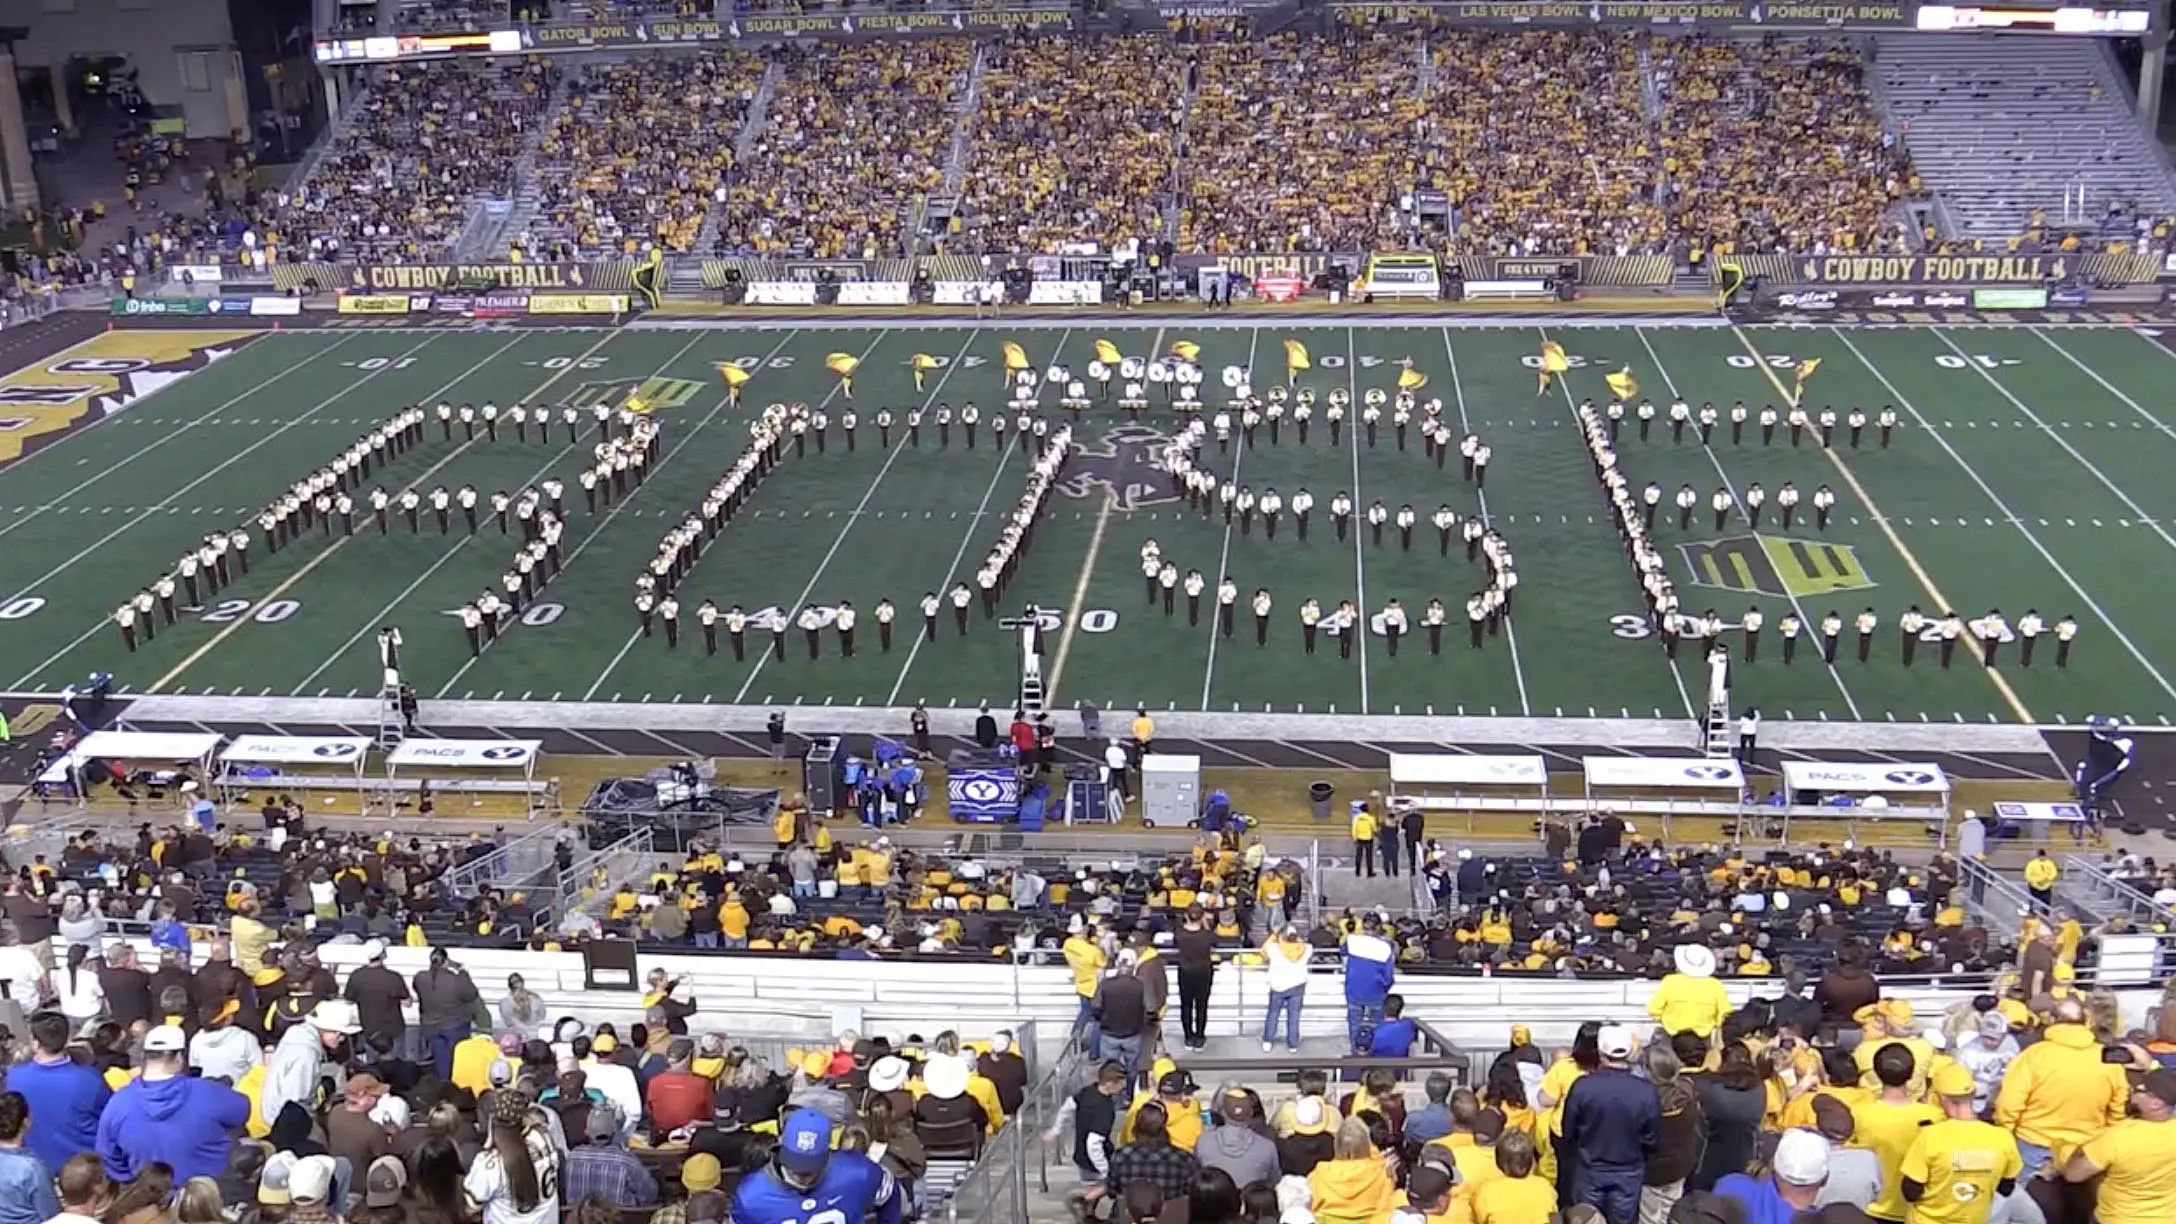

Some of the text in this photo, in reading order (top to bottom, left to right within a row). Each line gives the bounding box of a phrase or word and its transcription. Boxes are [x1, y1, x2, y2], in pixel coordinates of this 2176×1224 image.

[1187, 7, 1244, 17] MEMORIAL
[1461, 5, 1584, 17] LAS VEGAS BOWL
[1607, 6, 1744, 18] NEW MEXICO BOWL
[1768, 6, 1904, 20] POINSETTIA BOWL
[746, 17, 837, 33] SUGAR BOWL
[859, 14, 947, 29] FIESTA BOWL
[969, 13, 1028, 26] HOLIDAY
[540, 28, 585, 42] GATOR
[591, 26, 631, 38] BOWL
[654, 22, 724, 36] SUN BOWL
[1824, 257, 2044, 281] COWBOY FOOTBALL
[372, 266, 450, 288] COWBOY
[201, 599, 301, 622] 20
[413, 748, 466, 757] PACS
[1808, 772, 1867, 781] PACS
[972, 783, 993, 798] Y
